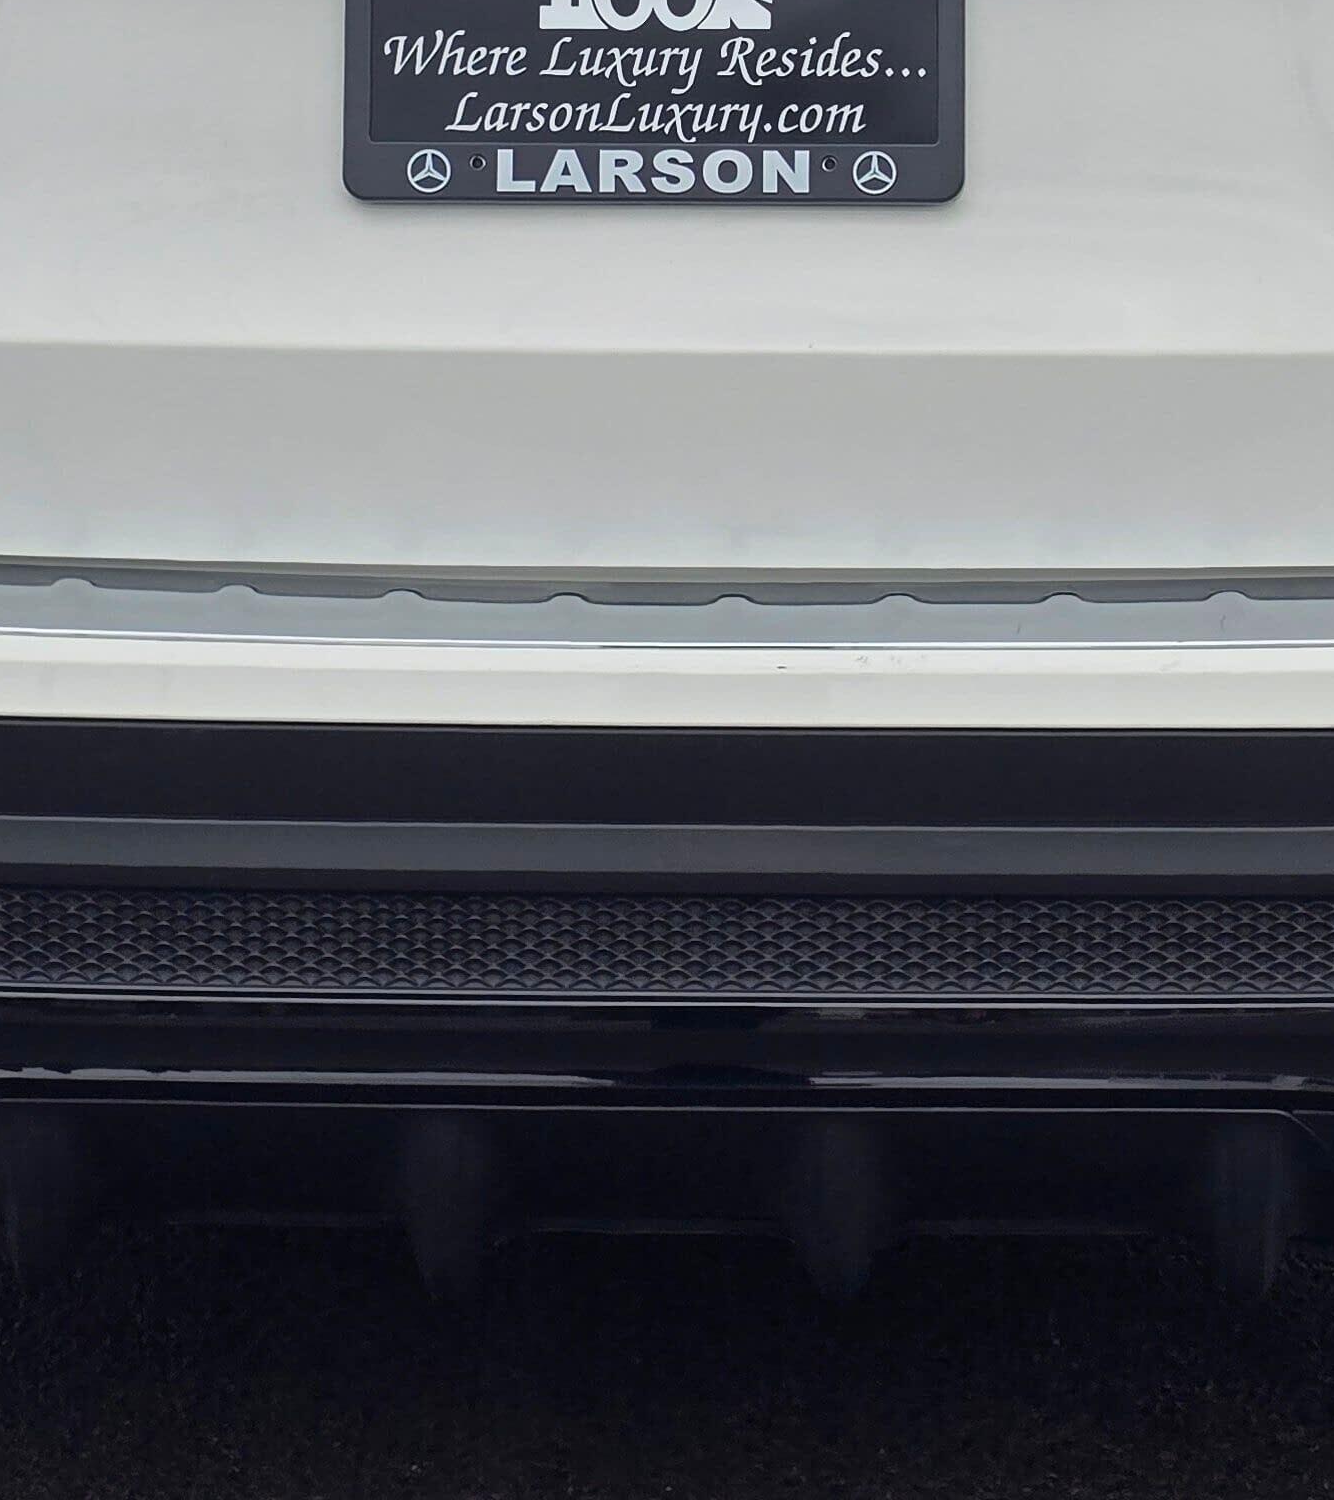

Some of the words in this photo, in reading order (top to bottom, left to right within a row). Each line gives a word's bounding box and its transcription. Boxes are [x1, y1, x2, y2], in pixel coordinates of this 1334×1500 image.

[383, 29, 527, 78] Where
[538, 36, 703, 96] Luxury
[716, 31, 927, 87] Resides...
[444, 91, 867, 145] LarsonLuxury.com
[496, 148, 810, 194] LARSON
